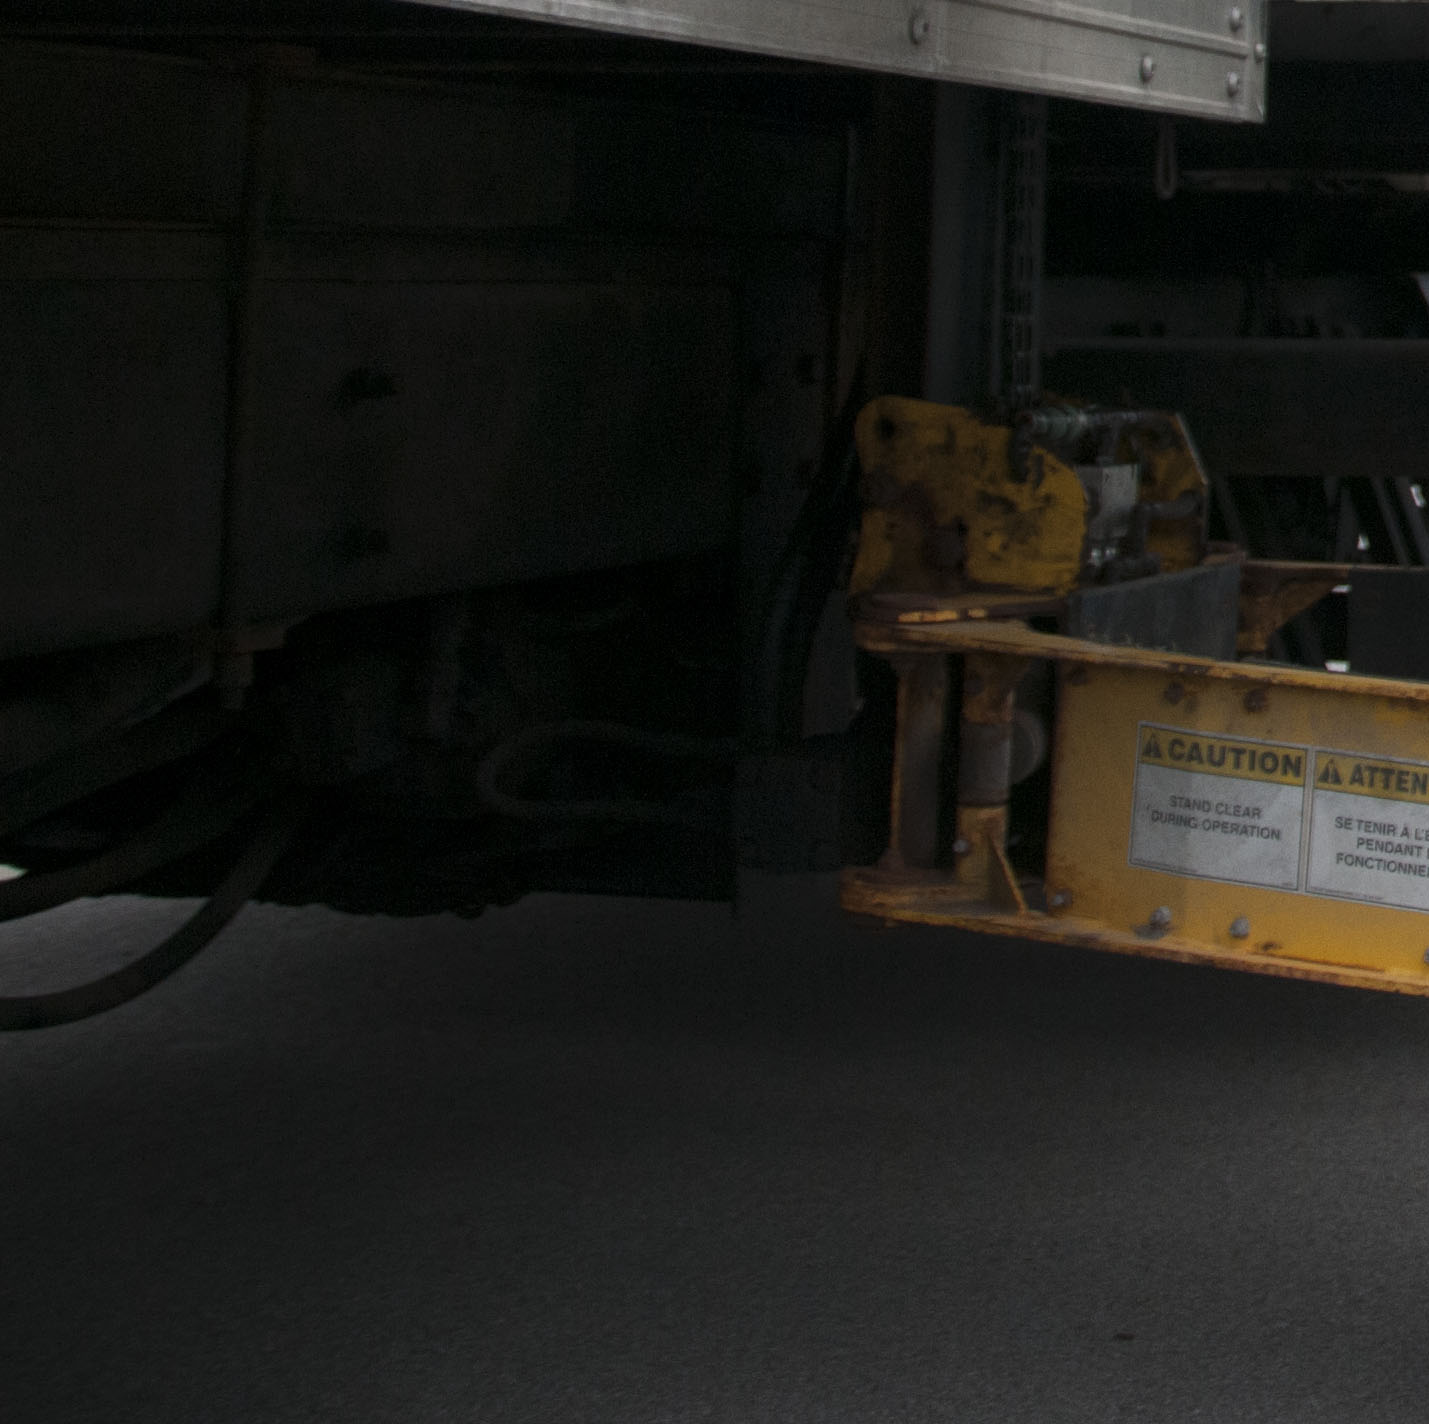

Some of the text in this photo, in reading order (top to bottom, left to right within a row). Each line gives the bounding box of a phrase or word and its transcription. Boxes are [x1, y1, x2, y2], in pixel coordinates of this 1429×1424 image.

[1168, 738, 1303, 777] CAUTION
[1169, 795, 1263, 819] STAND CLEAR
[1151, 810, 1281, 841] DURING OPERATION
[1335, 816, 1353, 831] SE
[1356, 819, 1396, 837] TENIR
[1356, 837, 1423, 859] PENDANT
